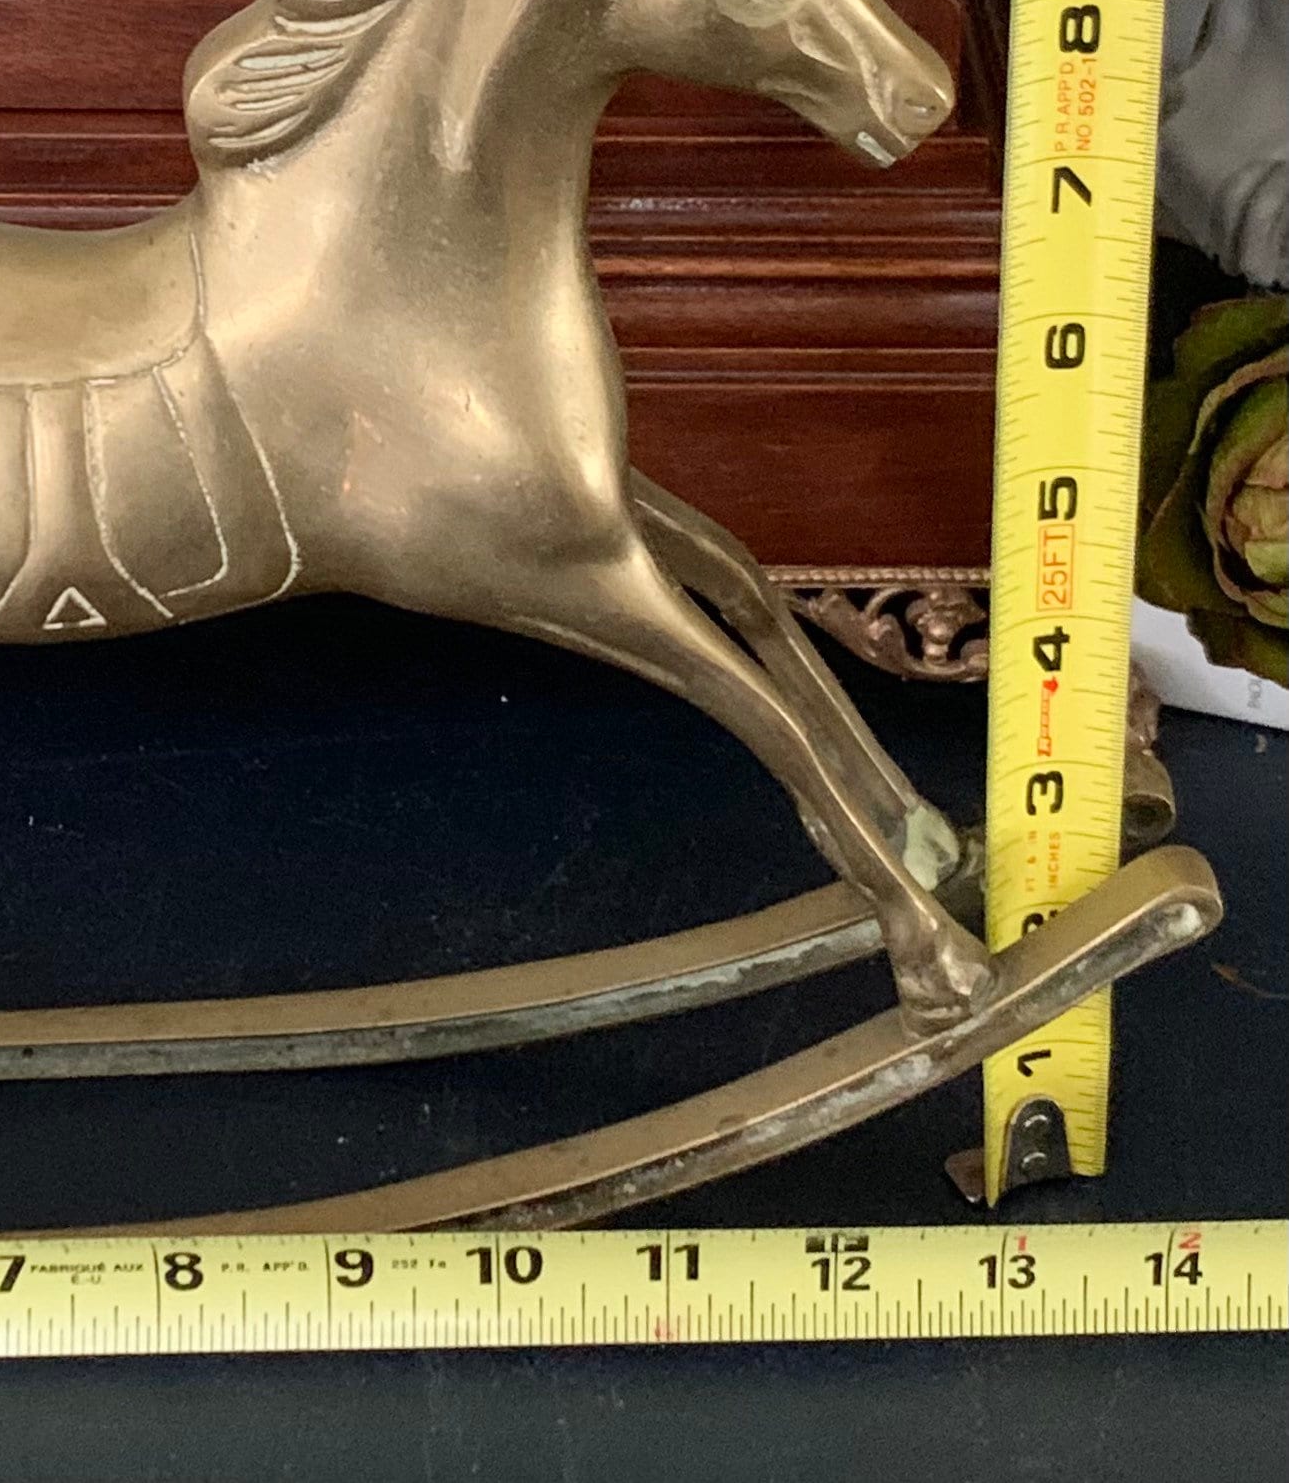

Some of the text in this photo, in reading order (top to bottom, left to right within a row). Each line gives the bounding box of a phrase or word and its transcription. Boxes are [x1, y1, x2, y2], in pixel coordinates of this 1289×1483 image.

[1058, 4, 1101, 54] 8
[1051, 166, 1092, 214] 7
[1044, 322, 1086, 370] 6
[1038, 476, 1078, 521] 5
[1033, 626, 1070, 672] 4
[1026, 770, 1064, 816] 3
[1017, 1049, 1051, 1077] 1
[163, 1252, 204, 1291] 8
[334, 1248, 375, 1288] 9
[465, 1246, 544, 1284] 10
[636, 1244, 701, 1282] 11
[811, 1256, 872, 1291] 12
[979, 1254, 1036, 1289] 13
[1145, 1251, 1202, 1286] 14
